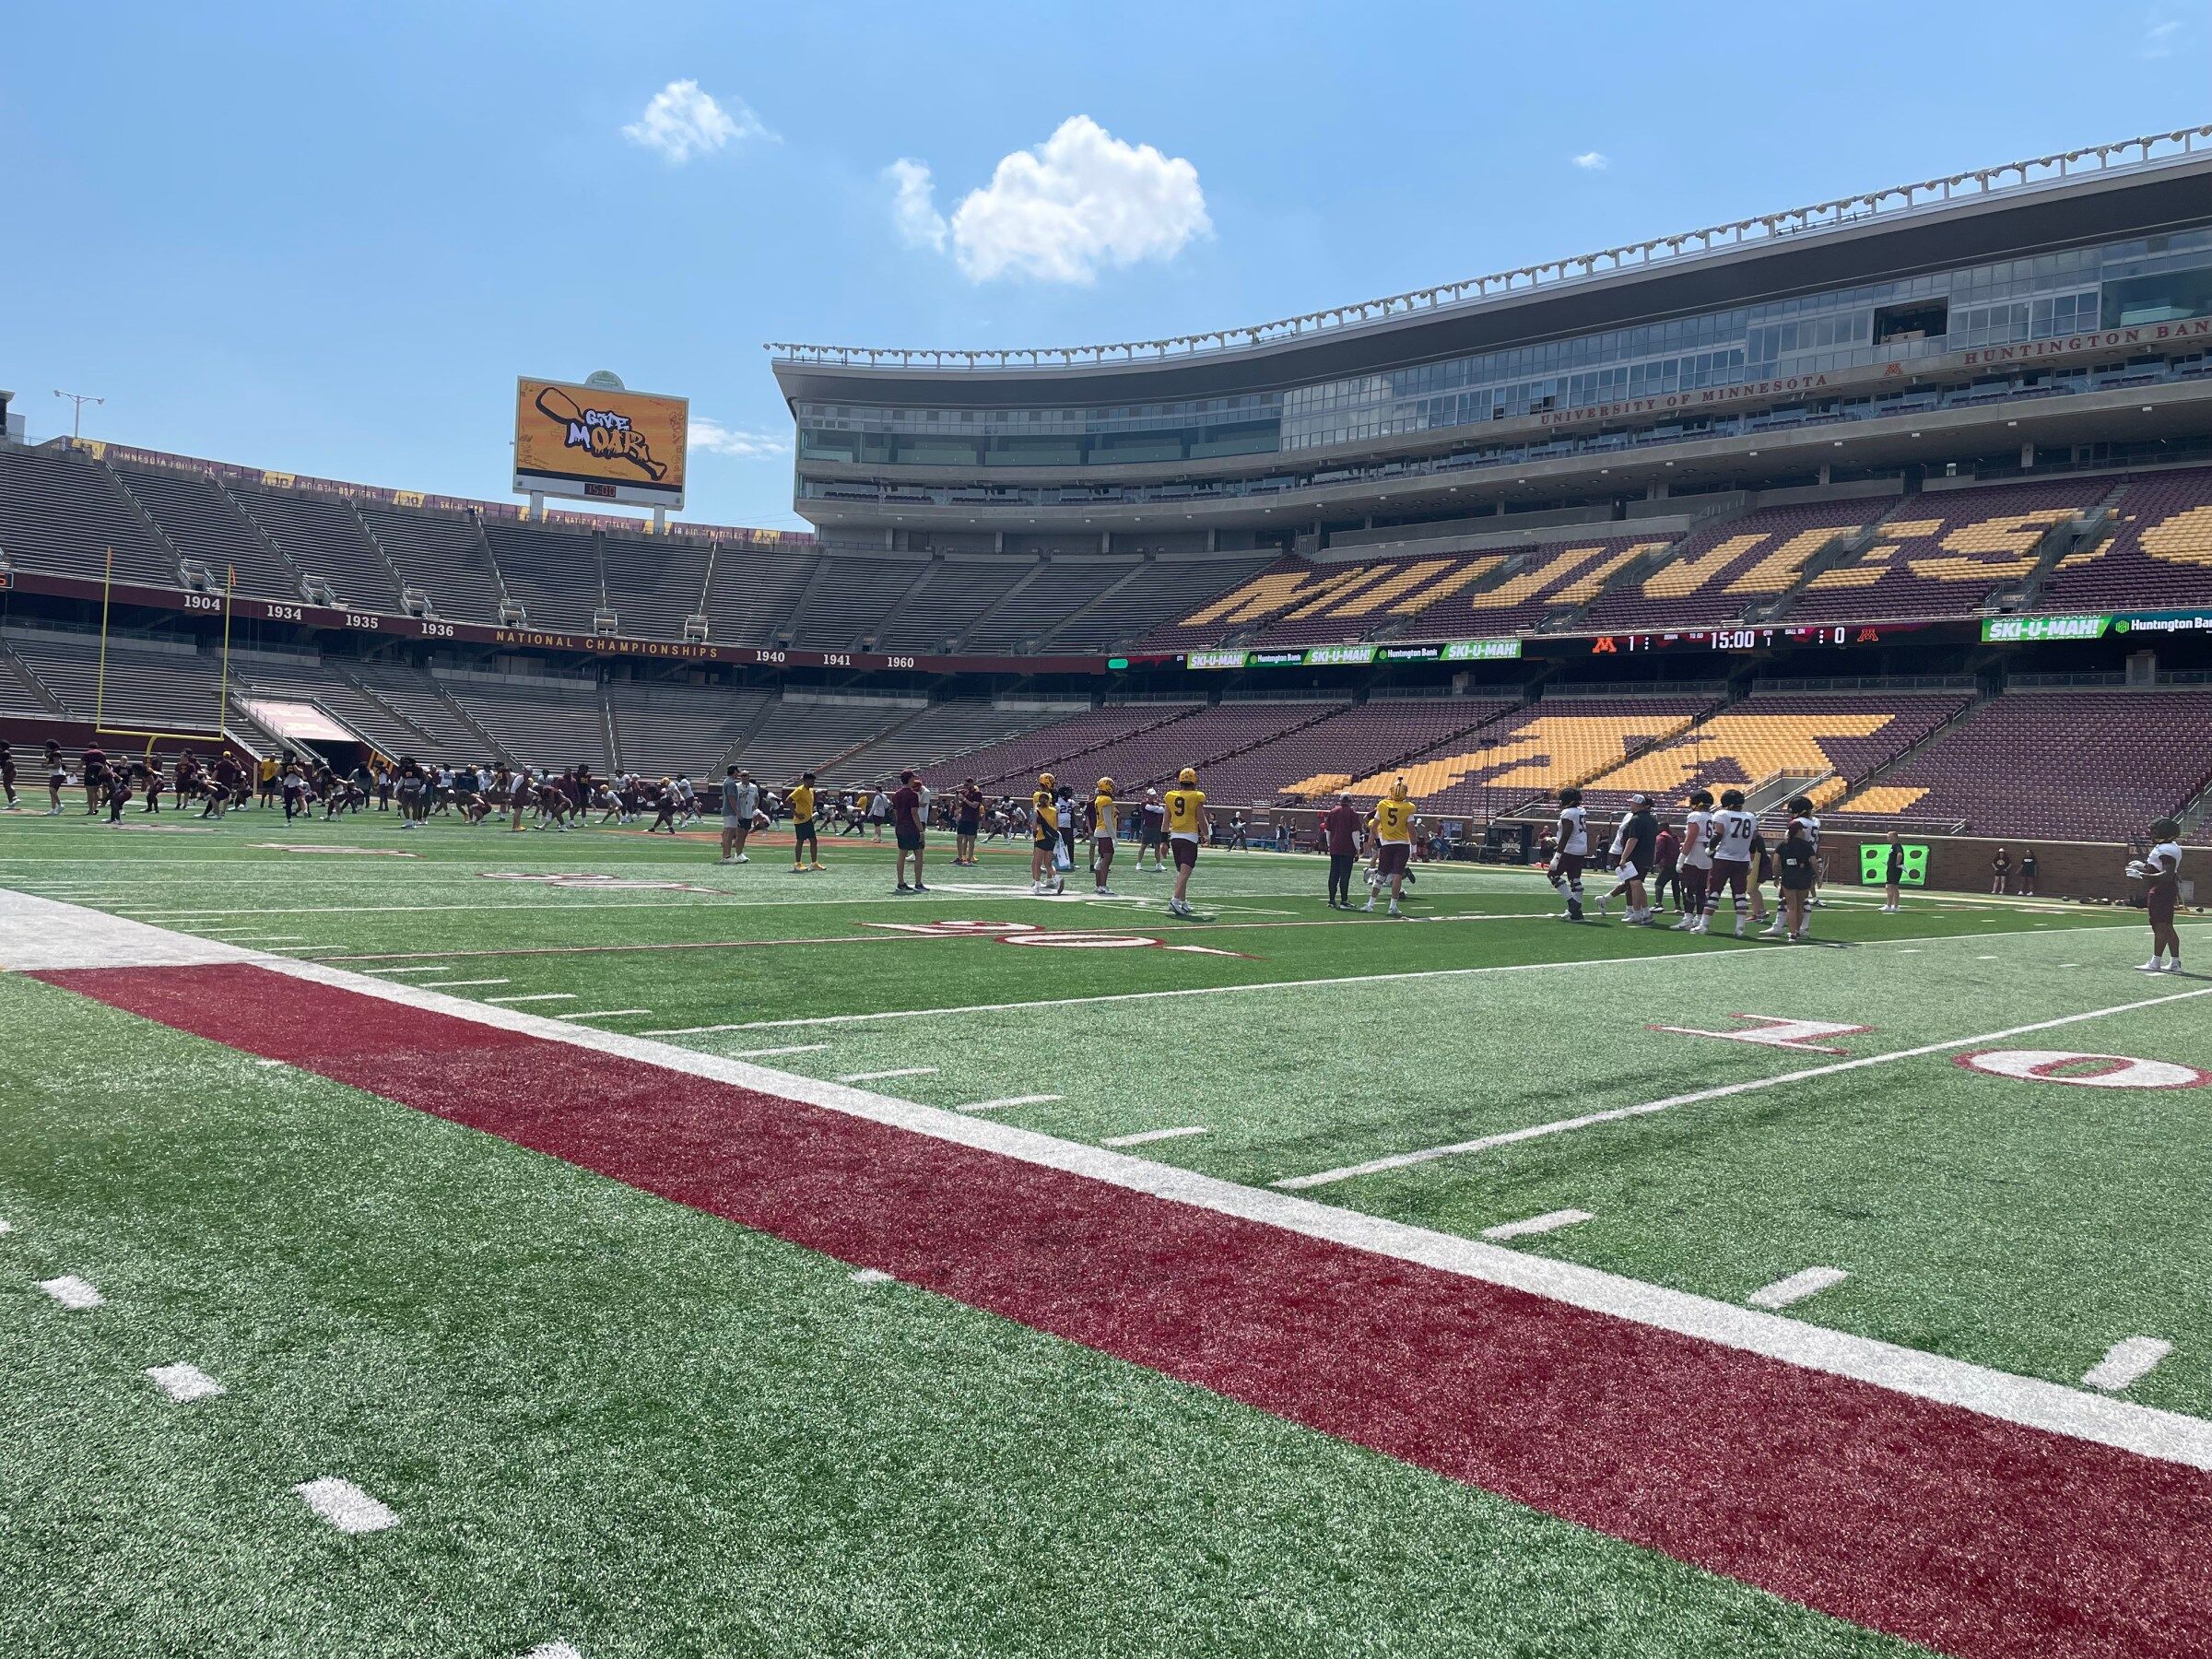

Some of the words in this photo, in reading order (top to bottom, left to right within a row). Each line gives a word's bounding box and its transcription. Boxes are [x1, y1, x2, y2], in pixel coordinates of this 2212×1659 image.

[1965, 329, 2140, 365] HUNTINGTON
[1541, 398, 1656, 426] UNIVERSITY
[1666, 394, 1690, 407] OF
[1702, 374, 1828, 402] MINNESOTA
[584, 409, 630, 432] GIVE
[184, 594, 221, 611] 1904
[267, 605, 302, 620] 1934
[346, 614, 379, 629] 1935
[421, 622, 454, 637] 1936
[1989, 618, 2098, 638] SKI-U-MAH!
[2131, 618, 2194, 632] Huntington
[1628, 635, 1635, 652] 1
[1711, 630, 1755, 649] 15:00
[1834, 627, 1845, 644] 0
[496, 630, 573, 648] NATIONAL
[585, 639, 718, 658] CHAMPIONSHIPS
[1449, 642, 1516, 658] SKI-U-MAH!
[756, 650, 785, 663] 1940
[823, 653, 851, 665] 1941
[1191, 653, 1243, 667] SKI-U-MAH!
[1257, 653, 1287, 665] Huntington
[1288, 653, 1301, 662] Bank
[1311, 649, 1371, 663] SKI-U-MAH!
[1387, 649, 1421, 660] Huntington
[1422, 647, 1438, 657] Bank
[887, 656, 914, 668] 1960
[1174, 796, 1186, 818] 9
[1387, 807, 1398, 827] 5
[1730, 817, 1751, 840] 78
